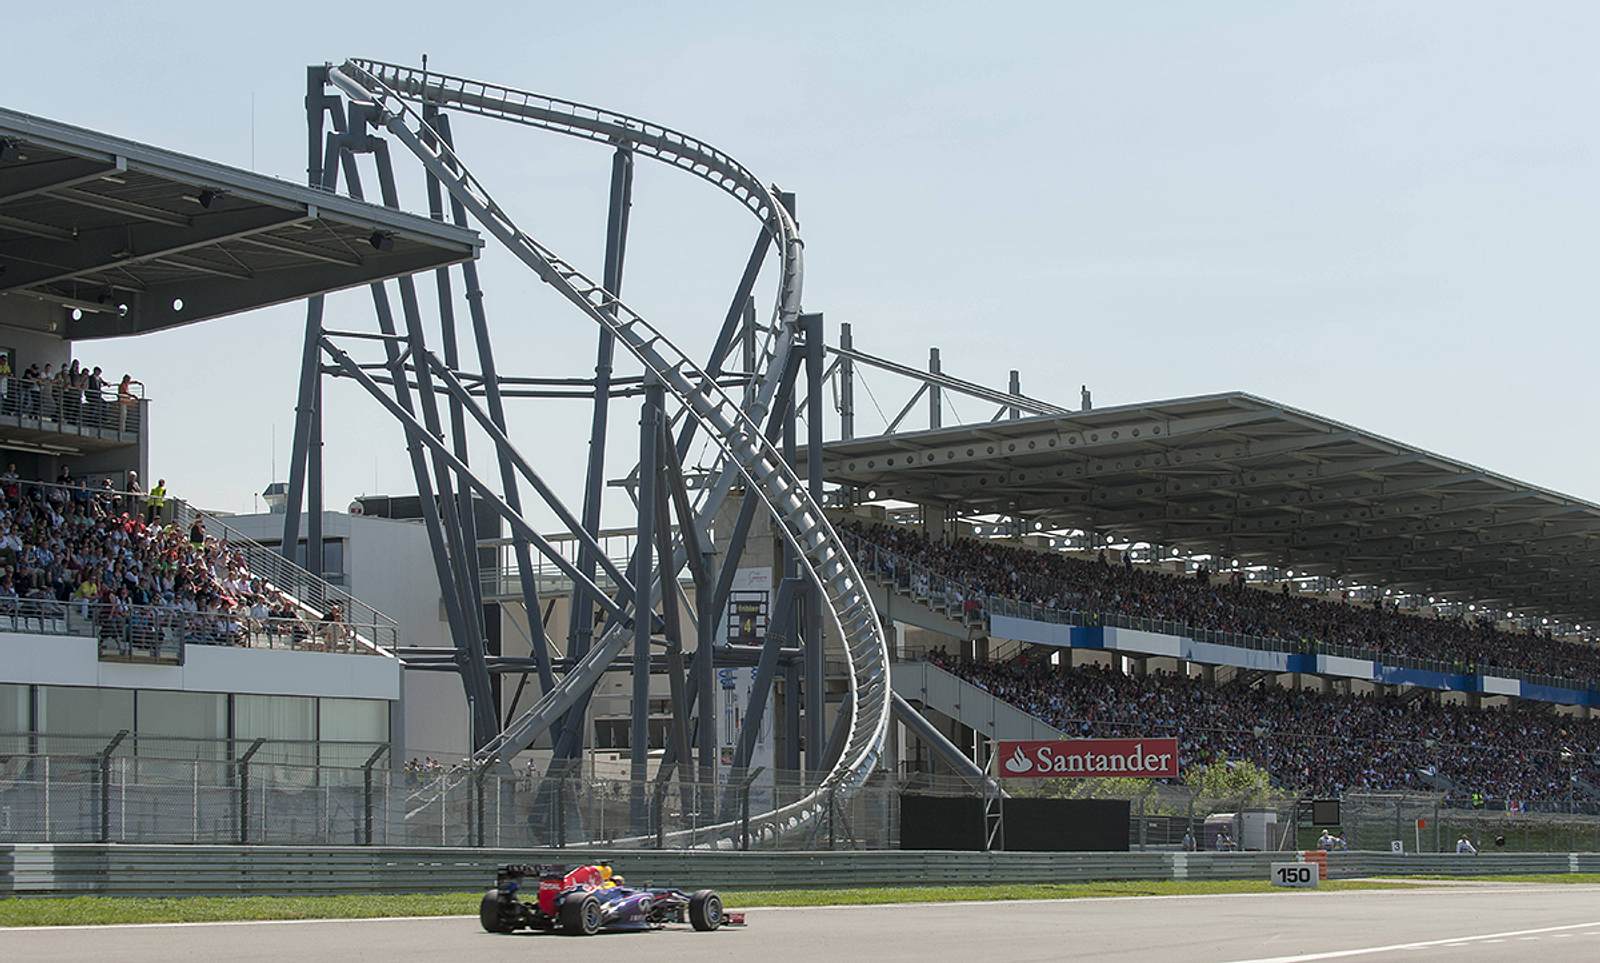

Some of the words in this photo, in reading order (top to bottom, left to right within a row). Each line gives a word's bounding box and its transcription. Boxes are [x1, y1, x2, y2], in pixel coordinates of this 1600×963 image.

[1036, 743, 1171, 772] Santander
[1394, 842, 1400, 851] 3
[1277, 867, 1310, 883] 150
